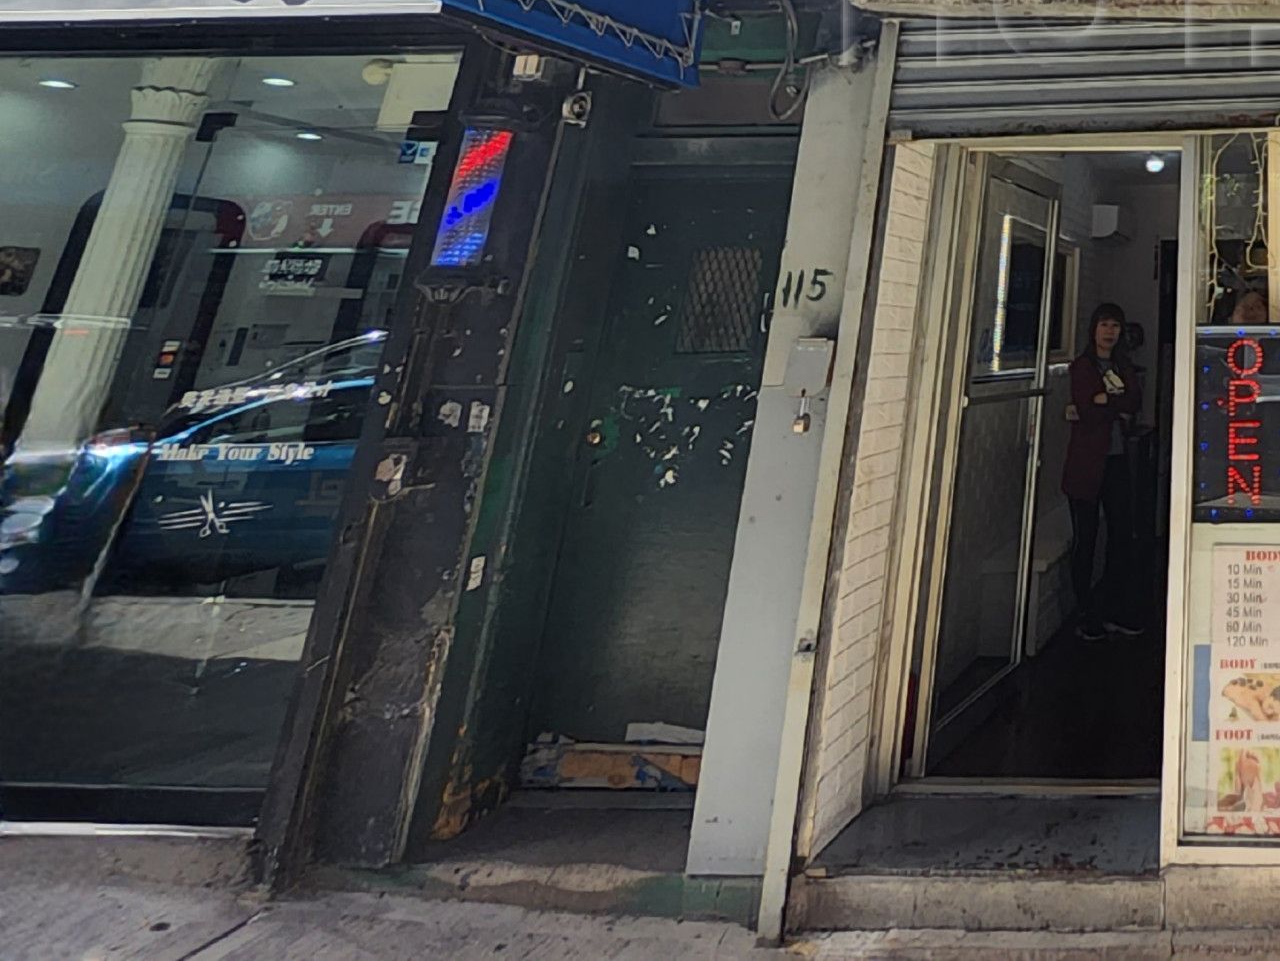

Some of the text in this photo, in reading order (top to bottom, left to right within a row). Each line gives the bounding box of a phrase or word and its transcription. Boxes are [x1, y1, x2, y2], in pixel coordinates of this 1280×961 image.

[782, 268, 834, 308] 115
[1226, 338, 1263, 506] OPEN
[217, 444, 263, 461] Your
[266, 441, 315, 465] Style
[1228, 564, 1240, 575] 10
[1243, 565, 1262, 575] Min
[1228, 579, 1240, 589] 15
[1243, 579, 1262, 589] Min
[1227, 593, 1240, 604] 30
[1243, 593, 1262, 604] Min
[1243, 607, 1262, 618] Min
[1242, 621, 1262, 633] Min
[1249, 636, 1269, 647] Min
